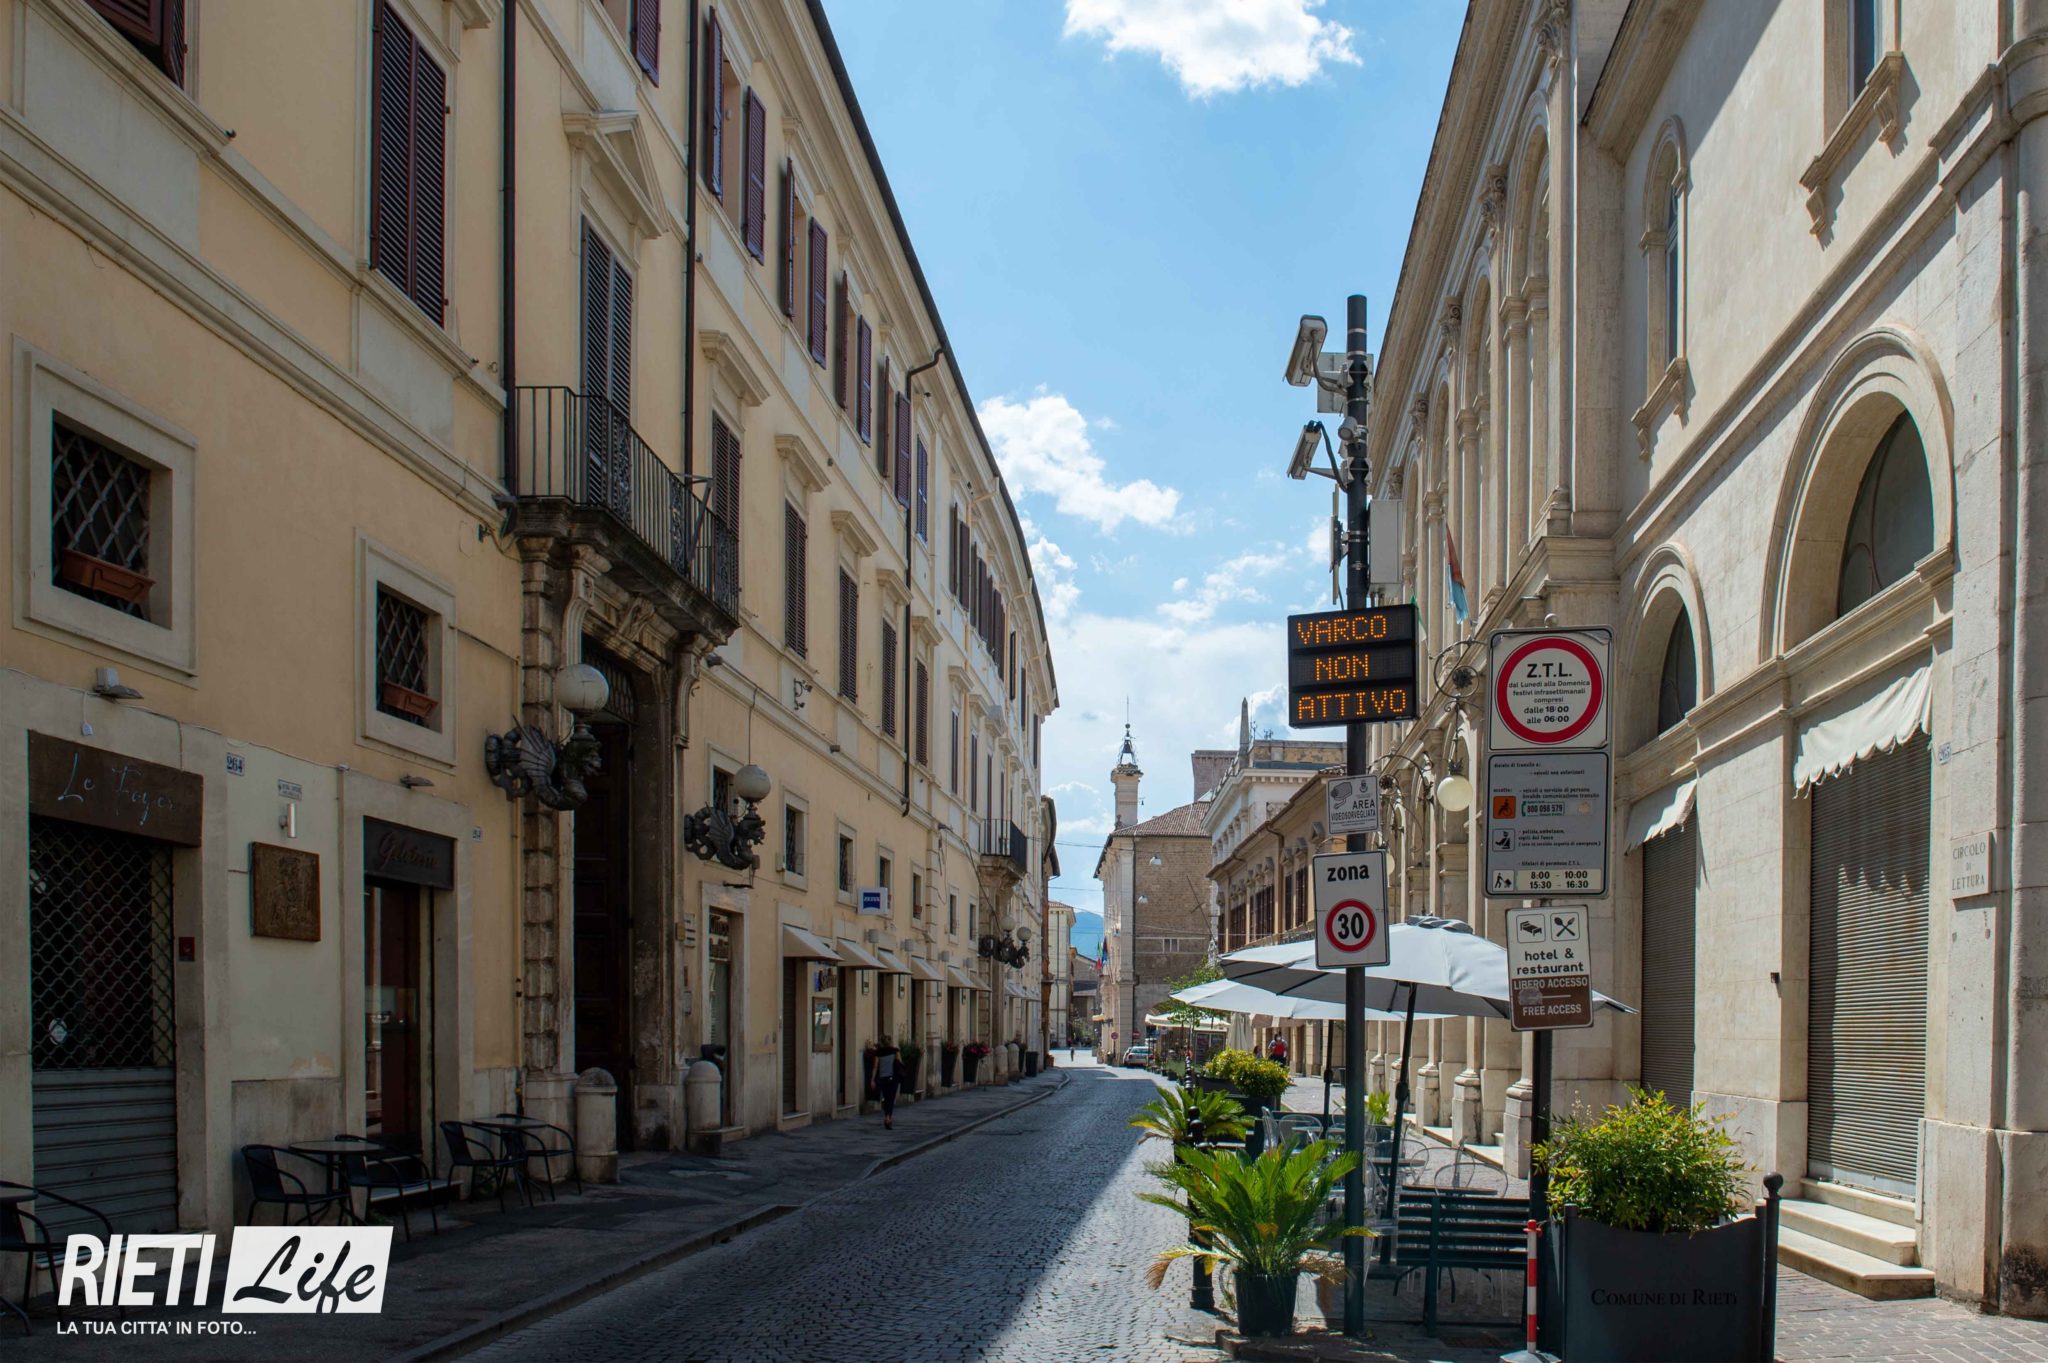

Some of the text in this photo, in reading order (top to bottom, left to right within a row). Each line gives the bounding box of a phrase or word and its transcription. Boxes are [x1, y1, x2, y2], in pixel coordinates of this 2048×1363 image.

[1297, 614, 1387, 645] VARCO
[1315, 654, 1369, 681] NON
[1527, 663, 1572, 678] Z.T.L.
[1297, 689, 1407, 720] ATTIVO
[1524, 706, 1544, 714] dalle
[1526, 716, 1541, 724] alle
[1352, 799, 1376, 810] AREA
[1331, 809, 1376, 821] VIDEOSORVEGLIATA
[1952, 841, 1986, 860] CIRCOLO
[1965, 861, 1972, 871] DI
[1327, 863, 1370, 884] zona
[1531, 871, 1550, 879] 8:00
[1565, 870, 1588, 879] 10:00
[1530, 881, 1552, 889] 15:30
[1566, 880, 1589, 889] 16:30
[1952, 874, 1985, 891] LETTURA
[1337, 912, 1364, 940] 30
[1524, 947, 1574, 961] hotel &
[1517, 962, 1584, 975] restaurant
[1514, 976, 1588, 990] LIBERO ACCESSO
[1522, 1003, 1582, 1016] FREE ACCESS
